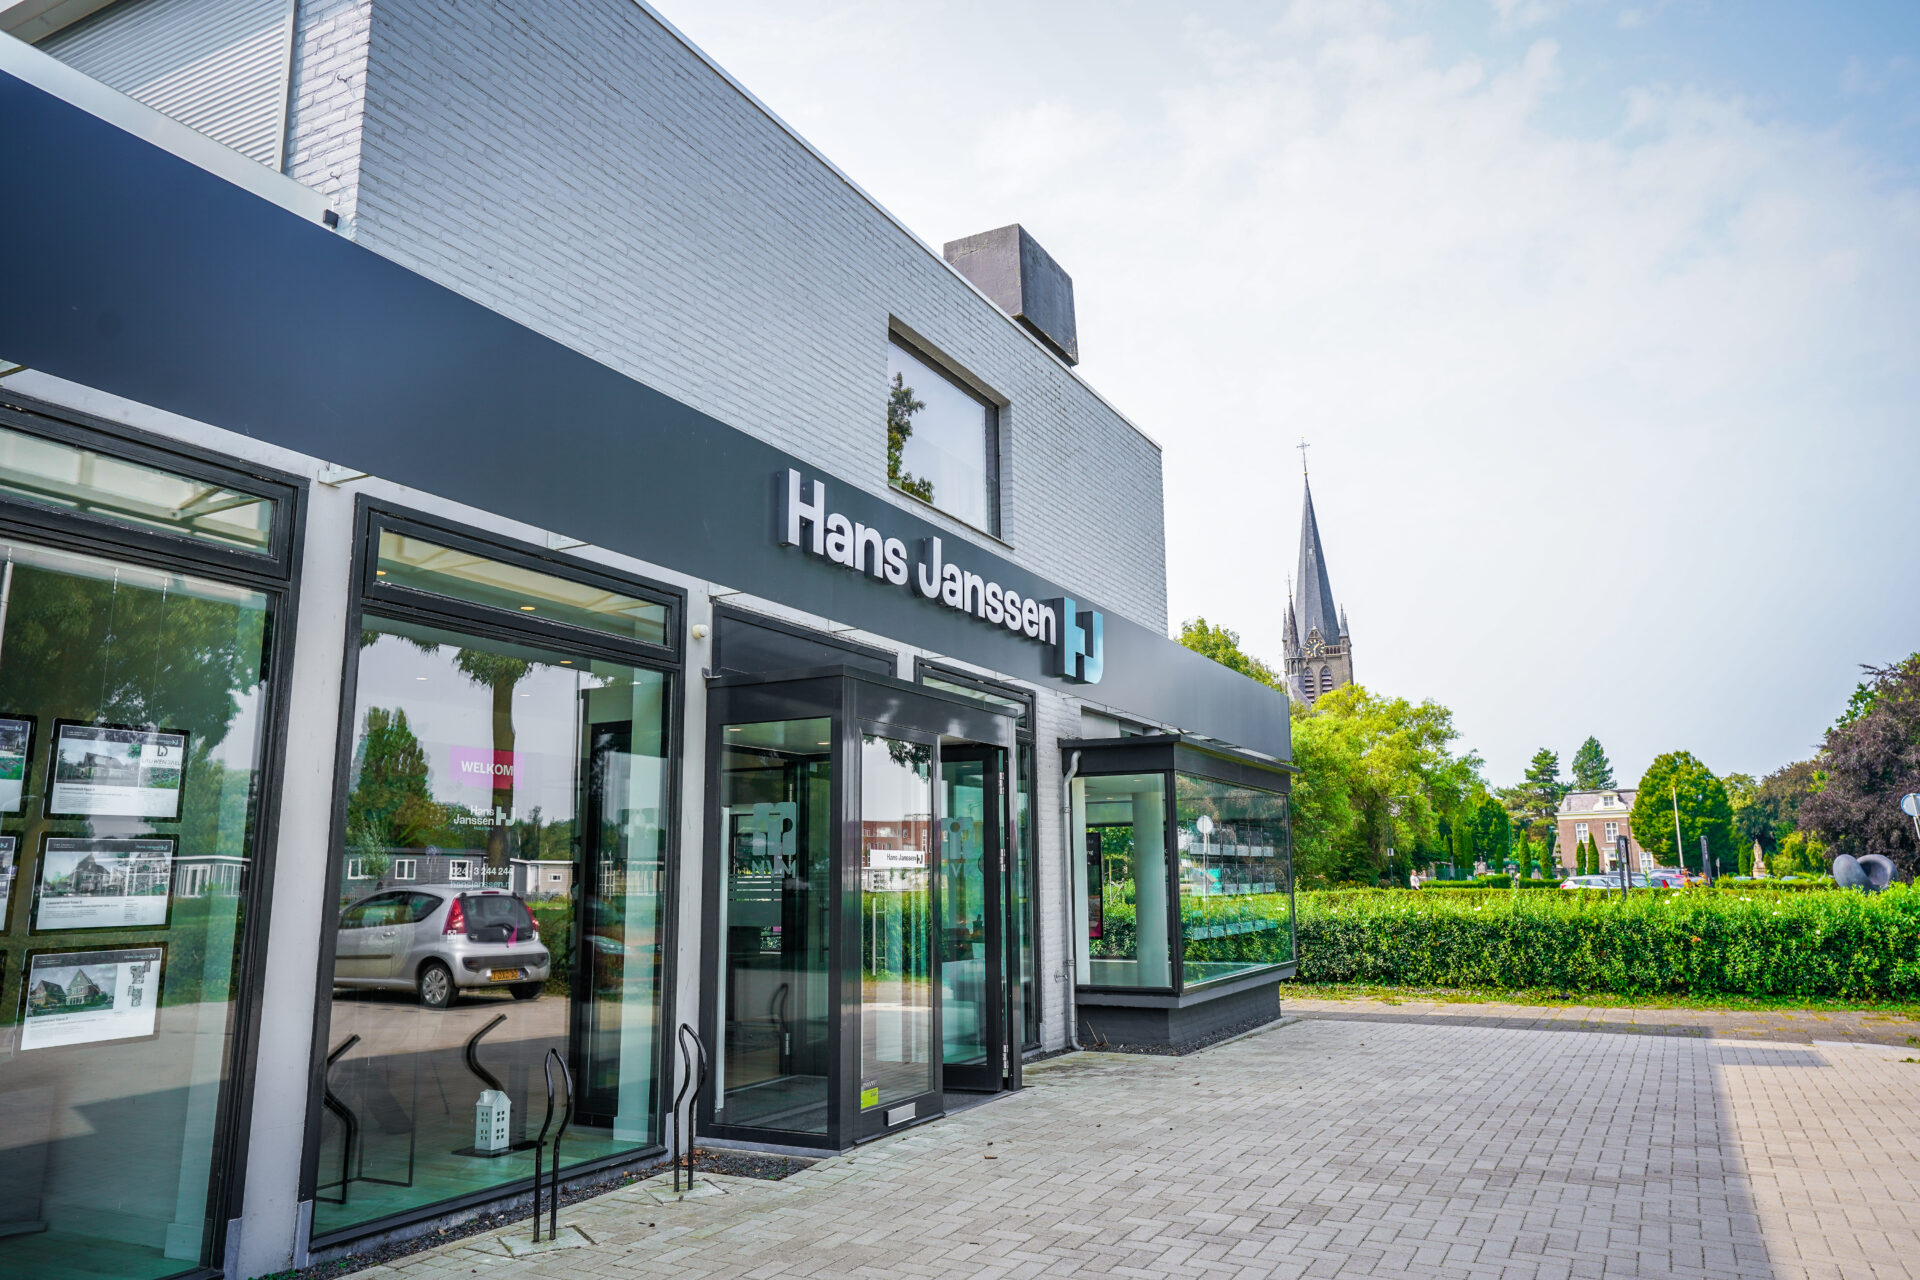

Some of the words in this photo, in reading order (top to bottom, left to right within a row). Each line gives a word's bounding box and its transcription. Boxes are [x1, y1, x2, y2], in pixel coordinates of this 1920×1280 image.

[786, 467, 909, 586] Hans
[917, 535, 1057, 646] Janssen
[460, 760, 514, 777] WELKOM
[470, 804, 495, 817] Hans
[453, 813, 495, 826] Janssen
[473, 867, 480, 876] 3
[481, 867, 497, 876] 244
[498, 867, 513, 876] 244
[752, 859, 796, 878] NVM
